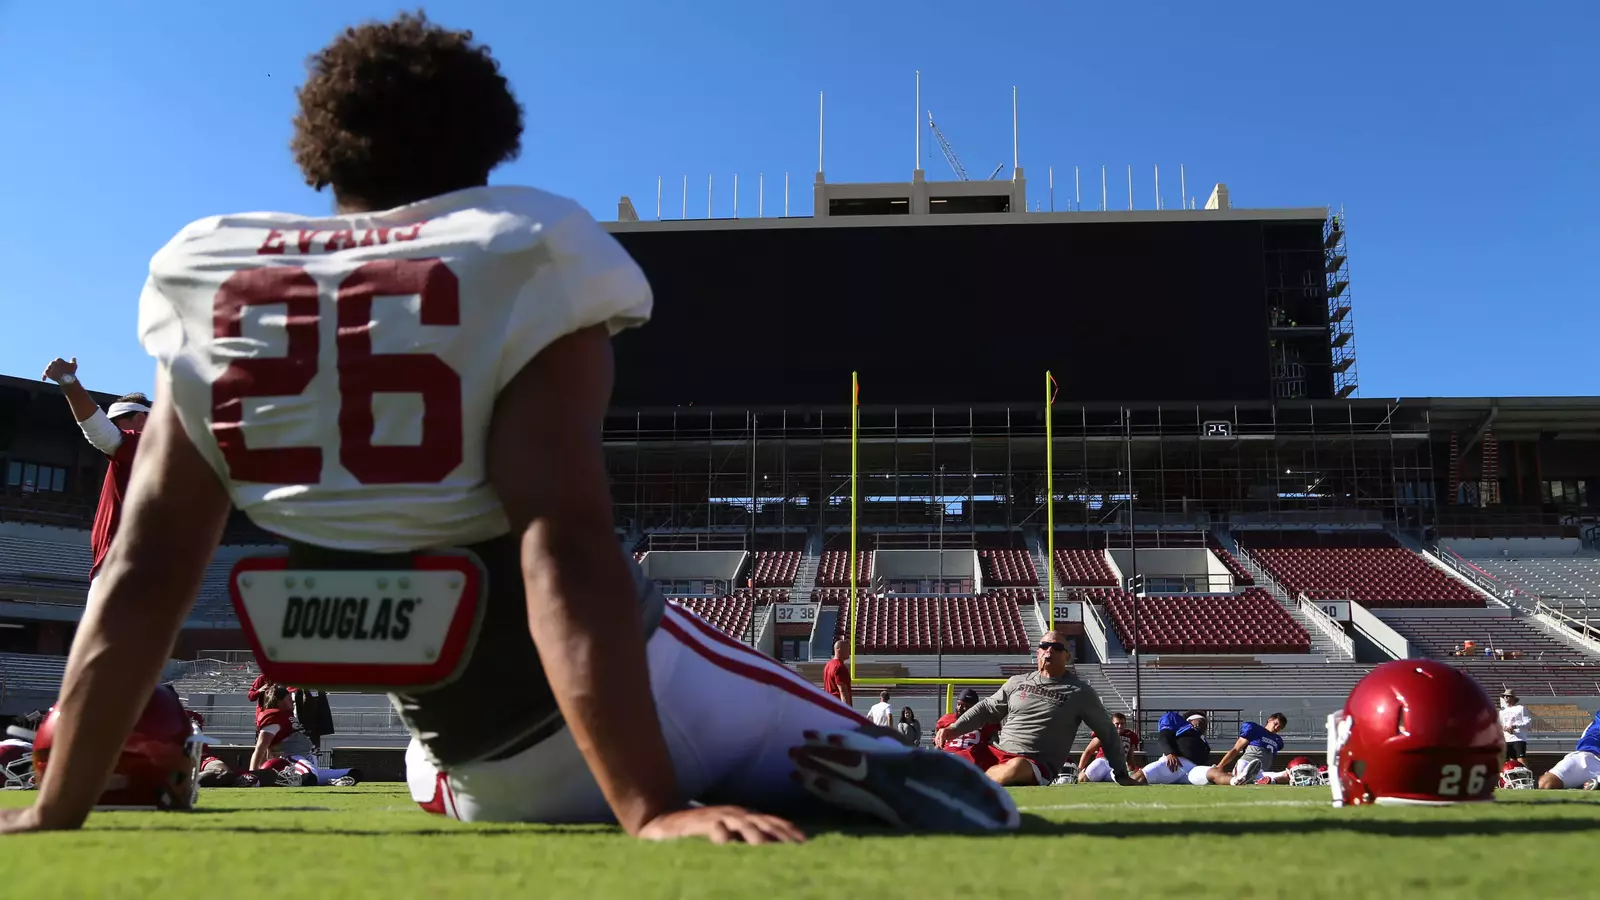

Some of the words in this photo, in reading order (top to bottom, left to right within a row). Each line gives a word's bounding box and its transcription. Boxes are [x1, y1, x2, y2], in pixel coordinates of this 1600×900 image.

[211, 258, 463, 485] 26
[281, 596, 415, 641] DOUGLAS
[1053, 606, 1069, 619] 39
[1438, 764, 1488, 795] 26
